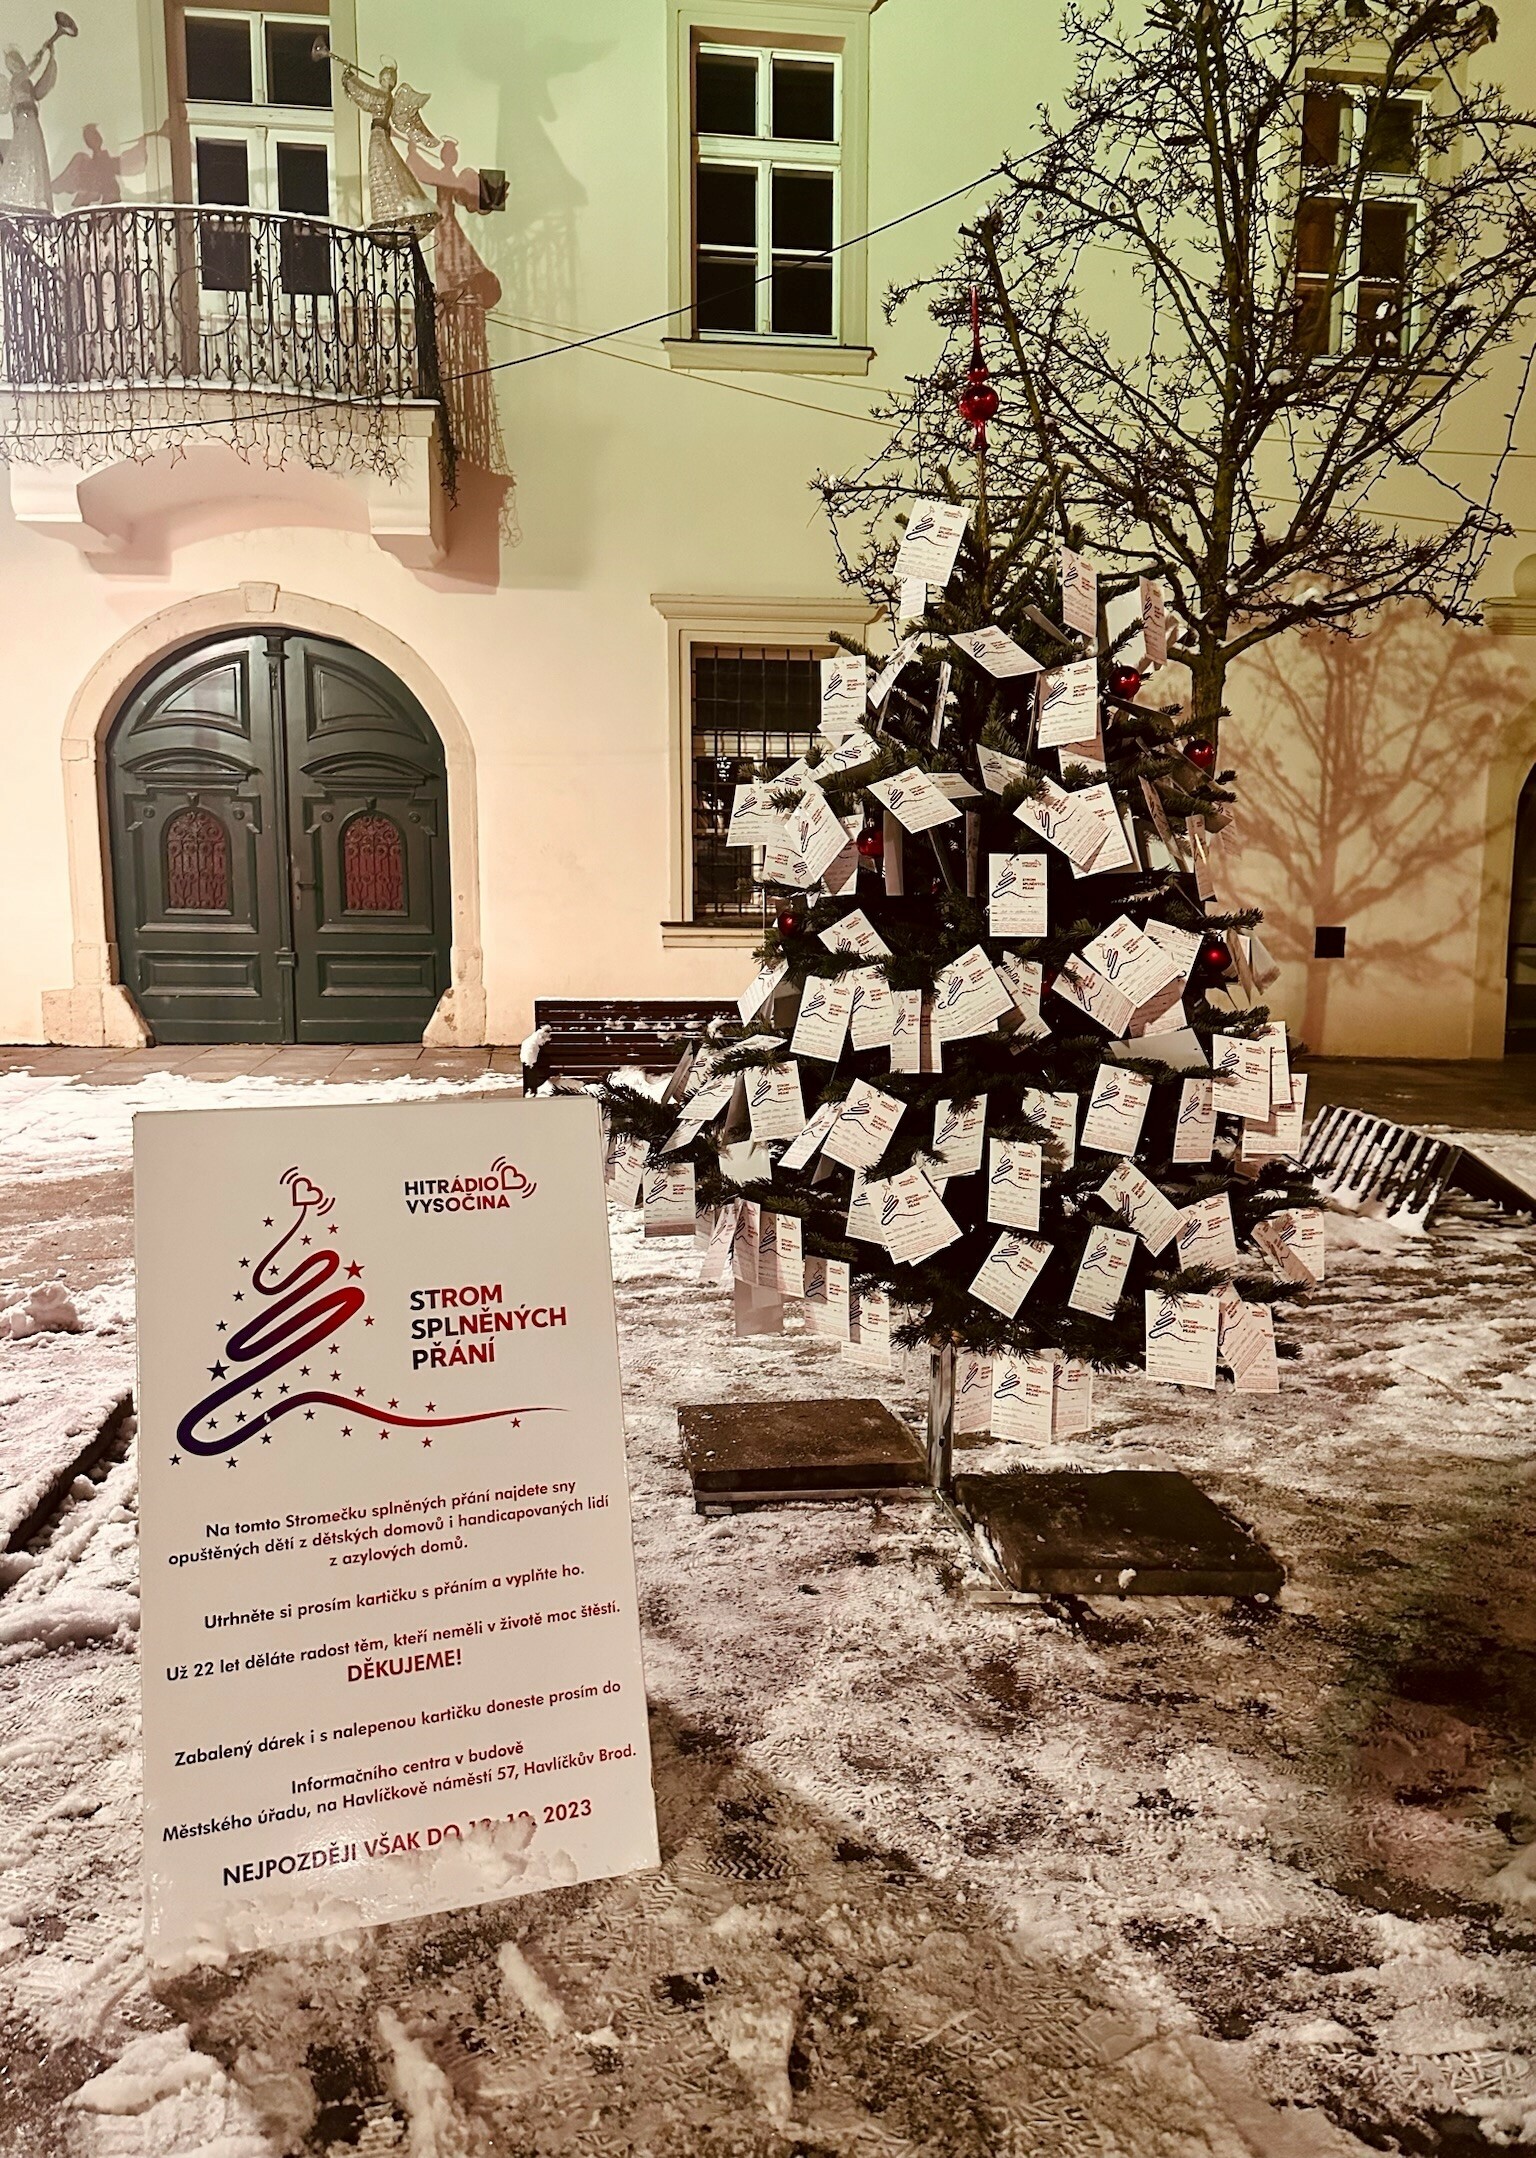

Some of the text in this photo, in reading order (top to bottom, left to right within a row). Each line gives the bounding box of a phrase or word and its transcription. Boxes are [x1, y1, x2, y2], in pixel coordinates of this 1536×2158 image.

[404, 1175, 499, 1196] HITRÁDIO
[405, 1193, 511, 1215] VYSOČINA
[409, 1284, 503, 1312] STROM
[411, 1304, 567, 1340] SPLNĚNÝCH
[412, 1337, 496, 1371] PŘÁNÍ
[168, 1495, 609, 1567] opuštěných dětí z dětských domovů i handicapovaných lidí
[206, 1481, 577, 1538] Na tomto Stromečku splněných přání najdete sny
[329, 1535, 468, 1567] z azylových domů.
[204, 1564, 585, 1629] Utrhněte si prosím kartičku s přáním a vyplňte ho.
[166, 1600, 621, 1681] Už 22 let děláte radost těm, kteří neměli v životě moc štěstí.
[347, 1648, 462, 1682] DĚKUJEME!
[175, 1680, 621, 1767] Zabalený dárek i s nalepenou kartičku doneste prosím do
[162, 1743, 637, 1842] Městského úřadu, na Havlíčkově náměstí 57, Havlíčkův Brod.
[291, 1740, 524, 1794] Informačního centra v budově
[223, 1841, 357, 1886] NEJPOZDĚJI
[364, 1830, 421, 1858] VŠAK
[543, 1799, 593, 1824] 2023
